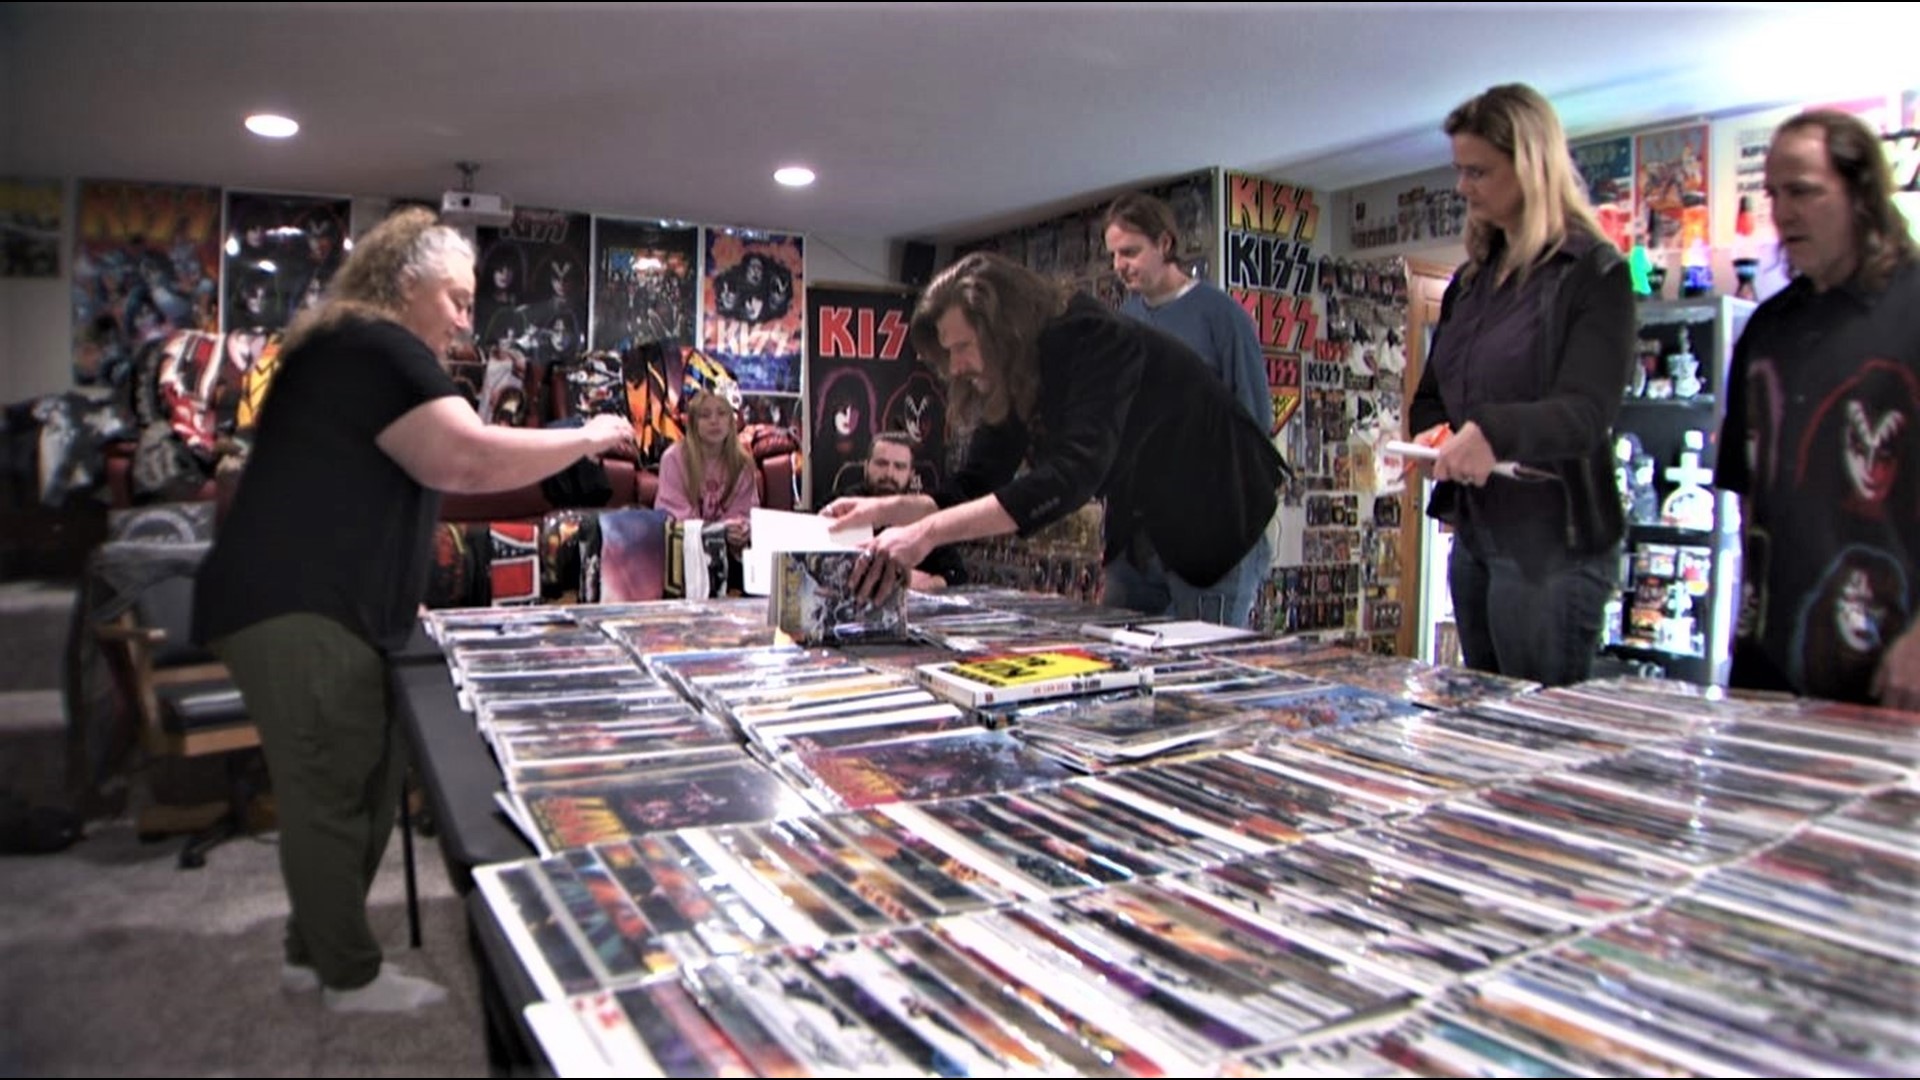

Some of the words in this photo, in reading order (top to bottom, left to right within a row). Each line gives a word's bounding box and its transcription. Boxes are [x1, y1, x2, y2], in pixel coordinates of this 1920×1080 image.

[1228, 172, 1320, 242] KISS
[1229, 232, 1316, 294] KISS
[715, 319, 790, 357] KISS
[819, 306, 909, 359] KIS
[1266, 358, 1298, 386] ISS
[1307, 361, 1341, 384] KISS
